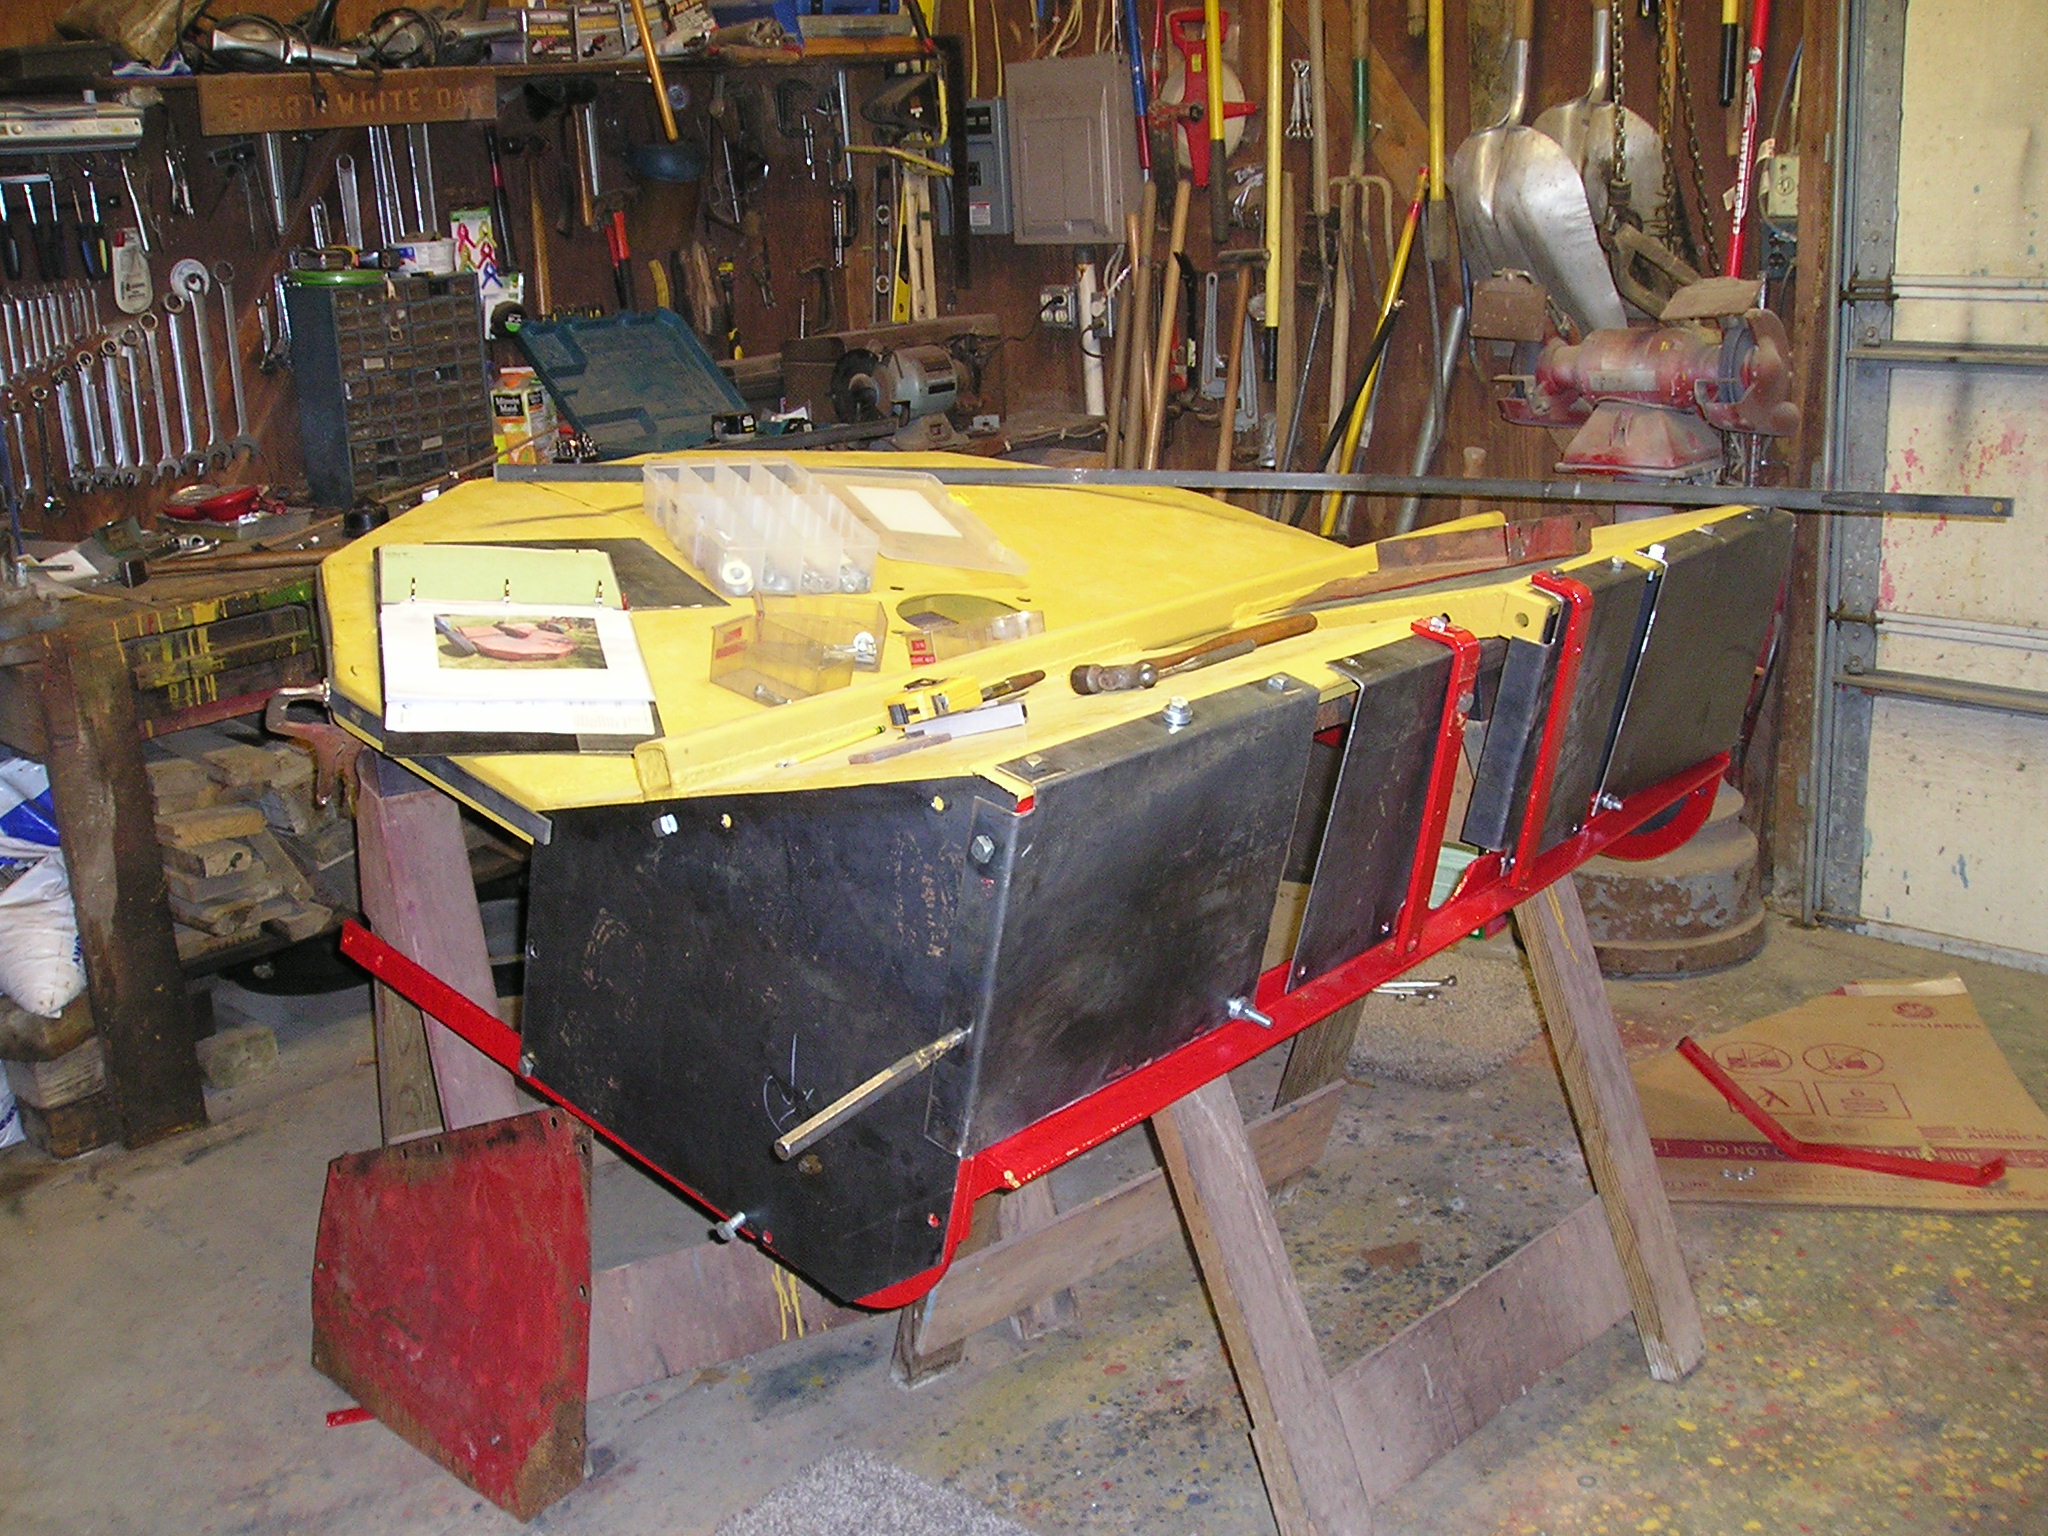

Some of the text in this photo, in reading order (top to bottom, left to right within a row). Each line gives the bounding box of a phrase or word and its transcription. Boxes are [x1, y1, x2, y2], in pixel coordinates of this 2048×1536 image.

[336, 87, 422, 115] WHITE
[436, 84, 485, 112] OAK
[1703, 1144, 1729, 1155] DO
[1733, 1145, 1767, 1157] NOT
